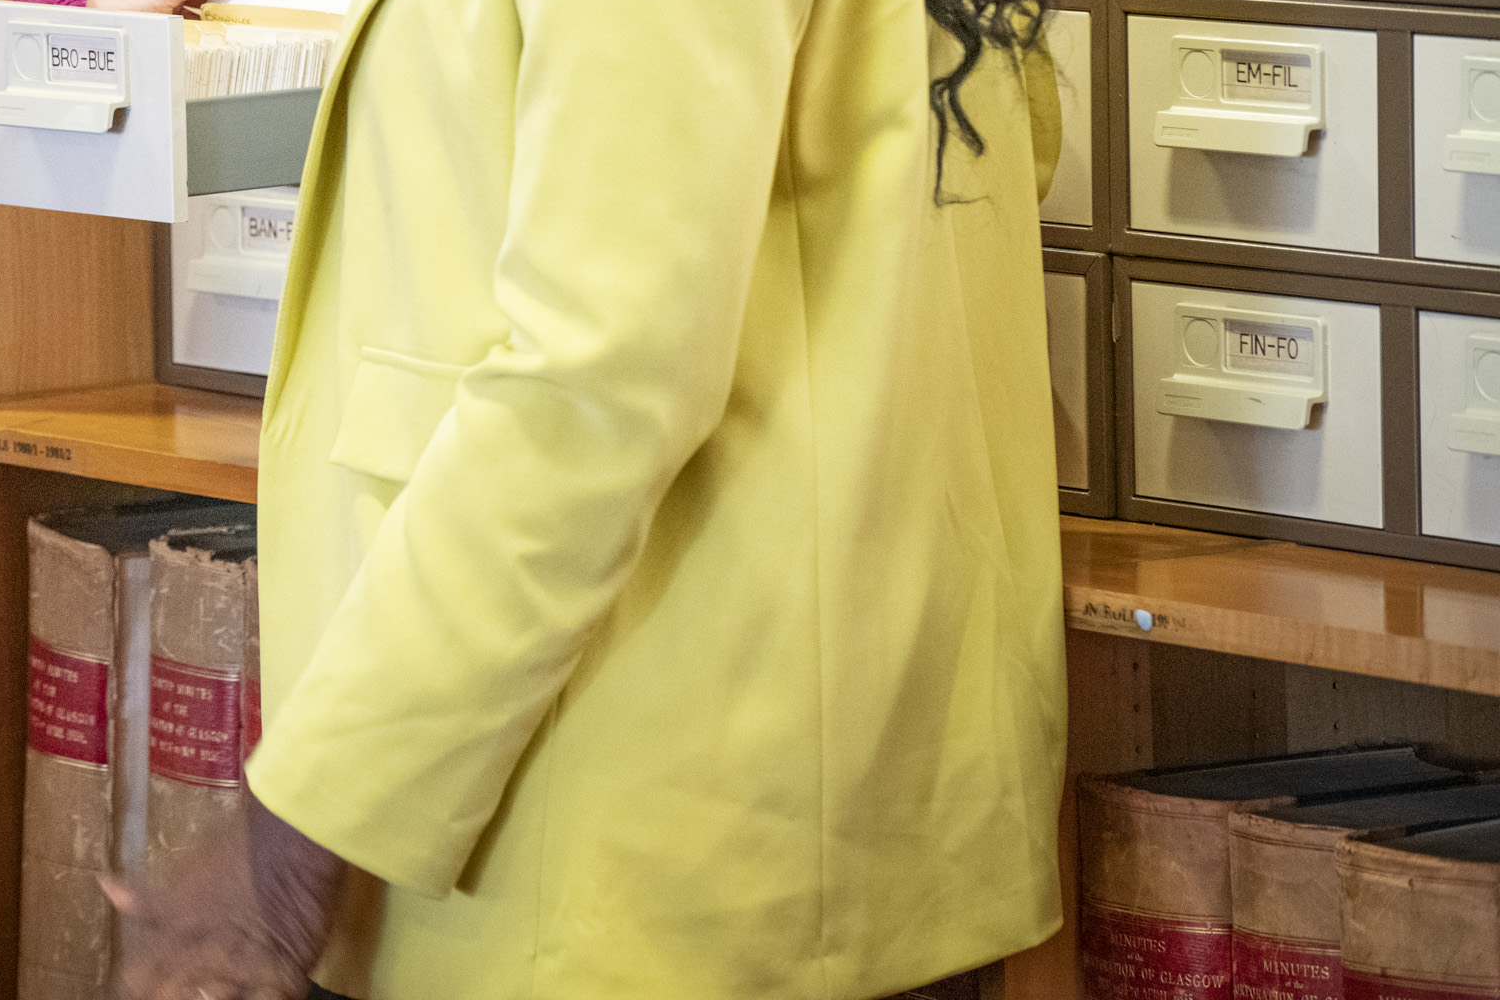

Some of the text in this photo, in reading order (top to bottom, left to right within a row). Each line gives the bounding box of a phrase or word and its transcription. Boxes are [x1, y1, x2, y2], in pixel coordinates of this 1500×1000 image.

[1236, 62, 1299, 89] EM-FIL
[1239, 333, 1299, 360] FIN-FO
[1140, 967, 1156, 981] OF
[1160, 971, 1225, 990] GLASGOW
[1262, 959, 1331, 980] MINUTES
